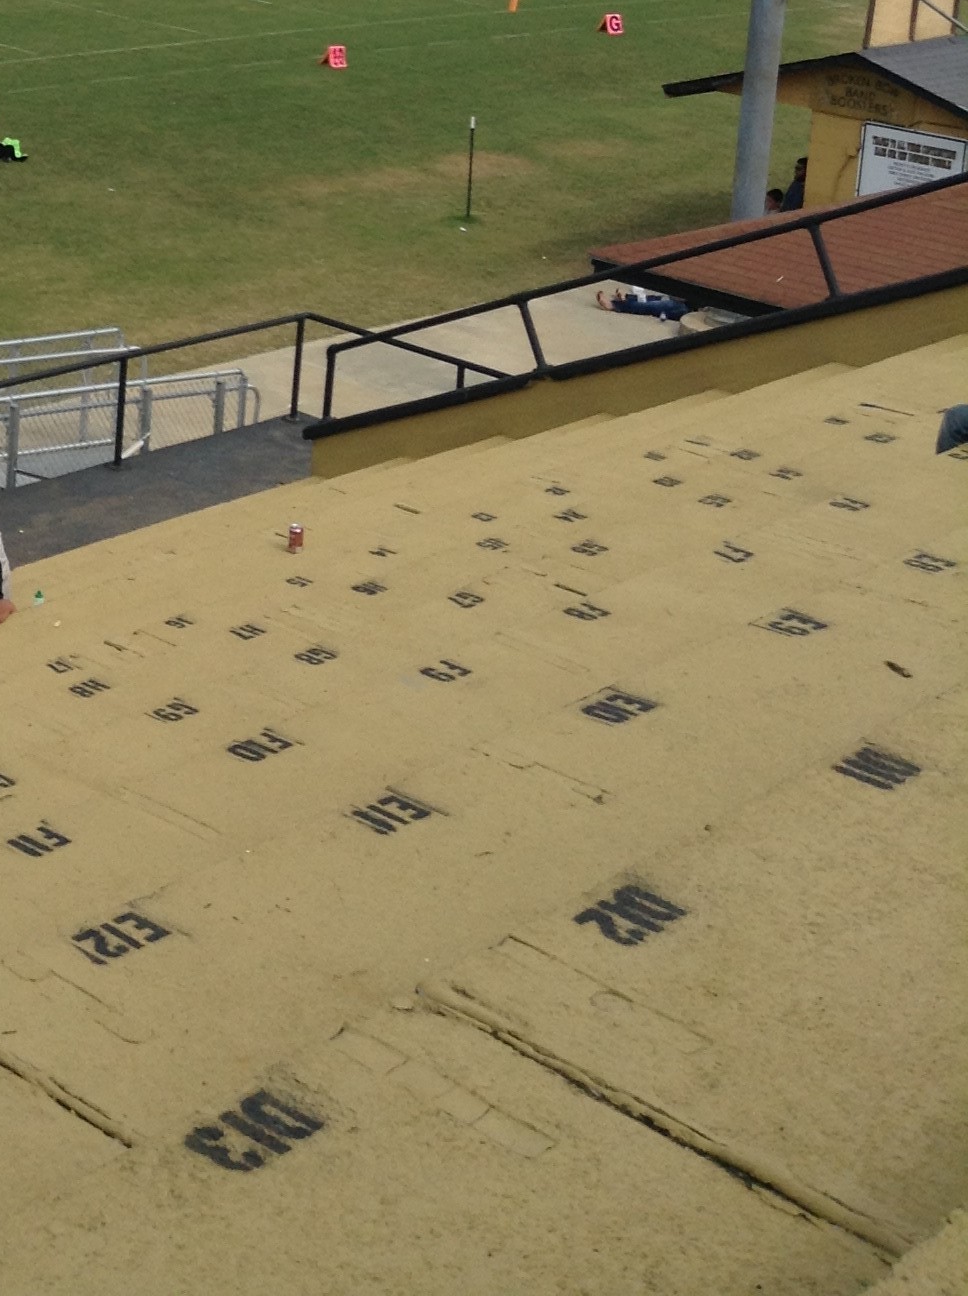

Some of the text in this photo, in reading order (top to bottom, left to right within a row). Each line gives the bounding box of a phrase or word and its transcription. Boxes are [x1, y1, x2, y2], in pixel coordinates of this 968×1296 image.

[608, 15, 622, 33] G
[713, 544, 754, 564] F7
[447, 591, 485, 609] G7
[562, 602, 612, 621] F8
[229, 624, 267, 641] H7
[767, 608, 829, 636] E9
[293, 647, 338, 666] G8
[419, 659, 472, 683] F9
[68, 678, 111, 698] H8
[152, 702, 200, 722] G9
[580, 693, 658, 724] E10
[226, 732, 294, 762] F10
[351, 794, 432, 833] E11
[6, 826, 73, 858] F11
[572, 882, 688, 947] D12
[71, 912, 173, 961] E12
[183, 1087, 325, 1173] D13
